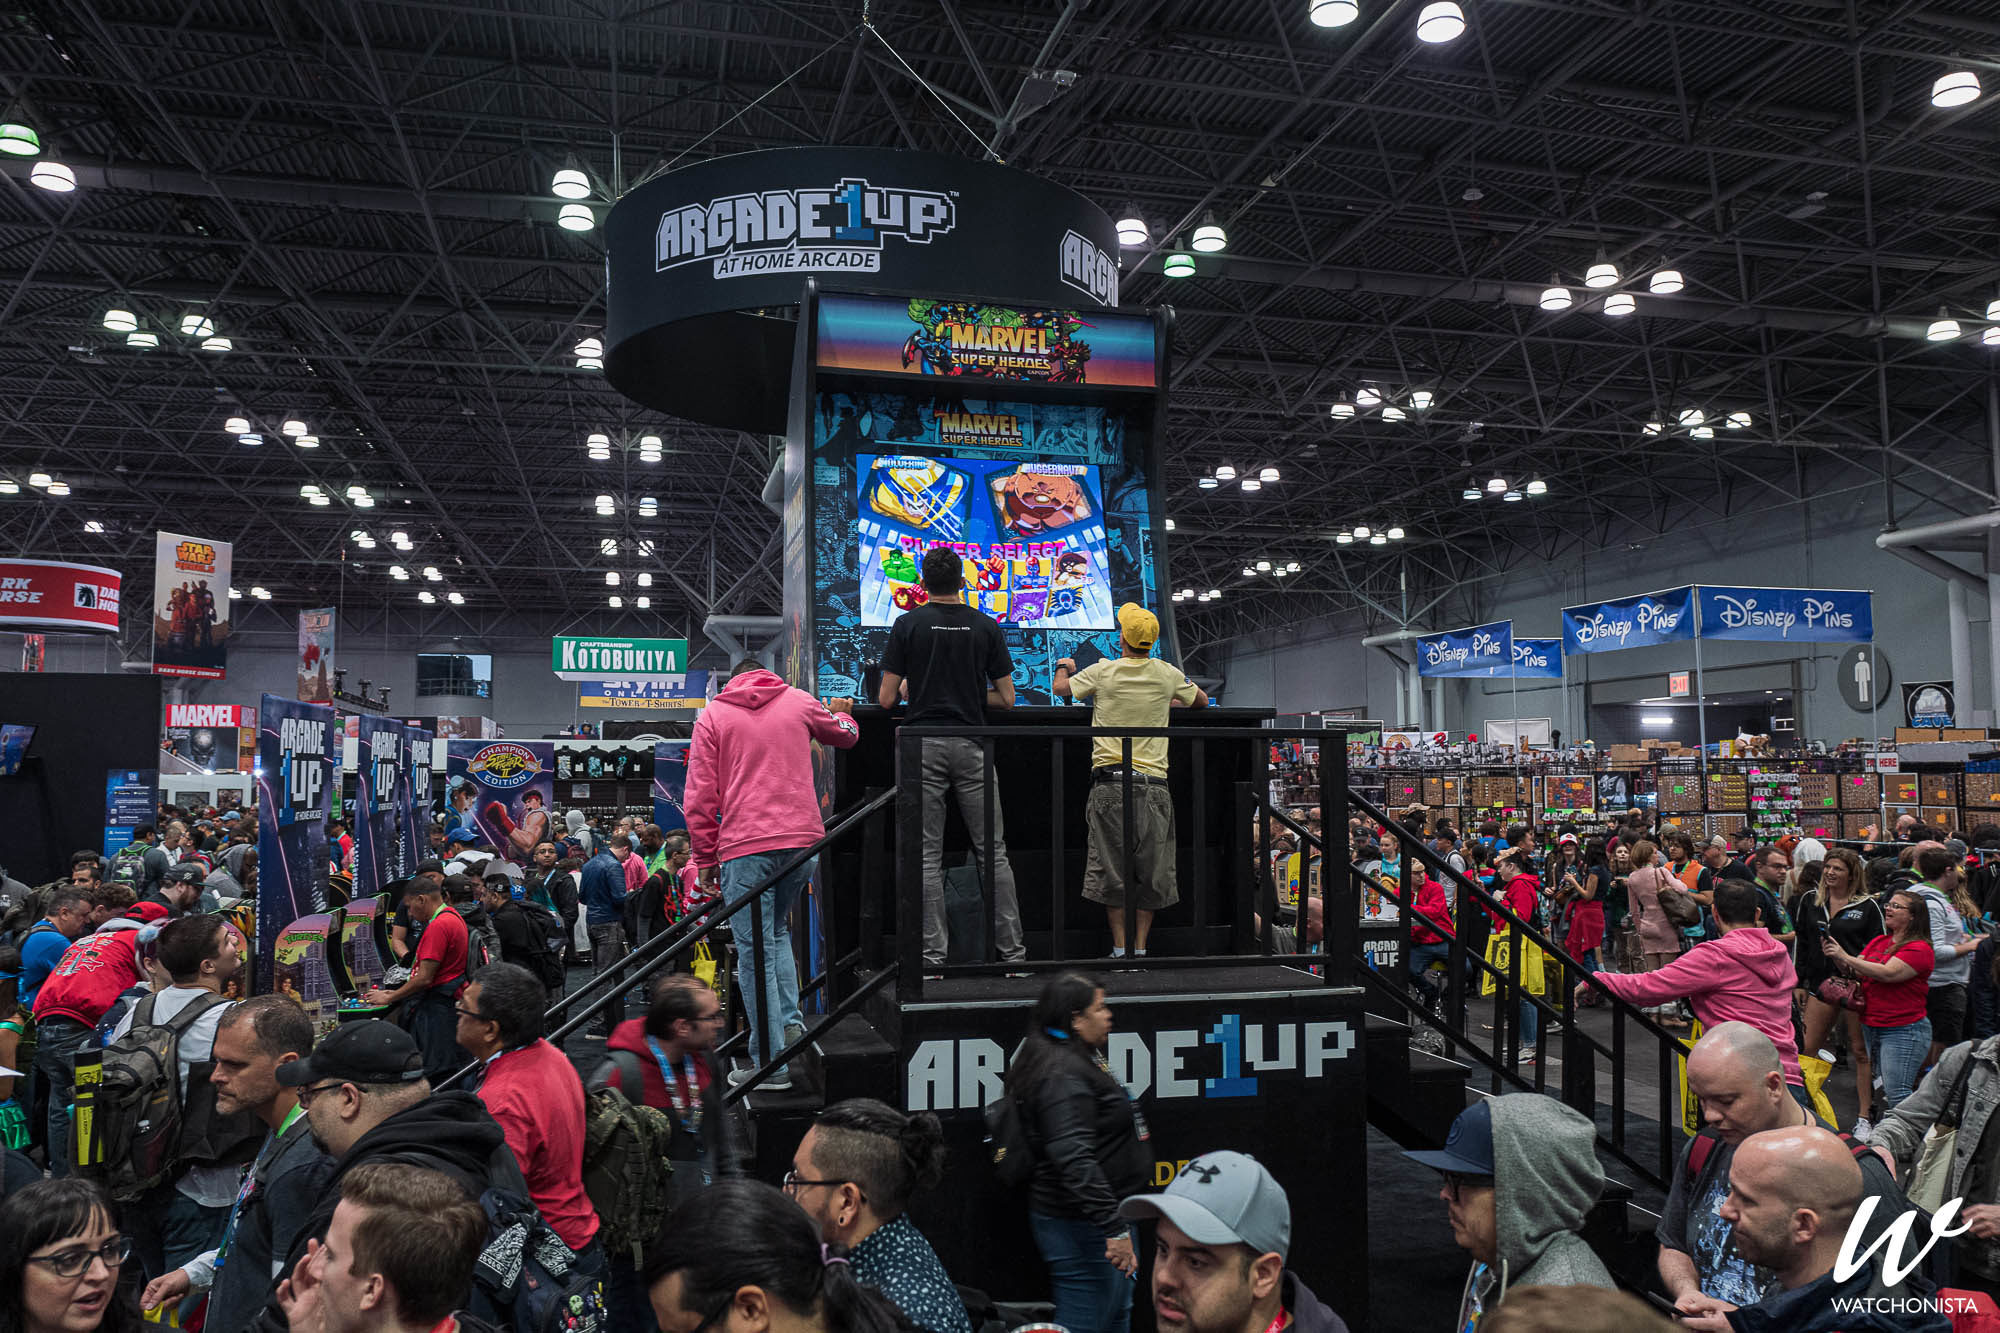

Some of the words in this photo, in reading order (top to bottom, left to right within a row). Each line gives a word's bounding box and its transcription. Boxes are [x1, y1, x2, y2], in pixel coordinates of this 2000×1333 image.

[718, 258, 736, 274] AT
[742, 253, 794, 271] HOME
[799, 252, 875, 268] ARCADE
[1063, 233, 1118, 307] ARCA
[951, 324, 1051, 354] MARVEL
[951, 353, 996, 367] SUPER
[999, 355, 1051, 369] HEROES
[942, 413, 1021, 436] MARVEL
[942, 434, 977, 446] SUPER
[980, 436, 1022, 447] HEROES
[990, 541, 1066, 560] SELECT
[1574, 613, 1632, 645] Disney
[1637, 603, 1679, 633] Pins
[1714, 594, 1795, 638] Disney
[1802, 598, 1853, 629] Pins
[562, 640, 676, 671] KOTOBUKIYA
[1426, 641, 1469, 667] Disney
[1472, 634, 1501, 659] Pins
[1670, 676, 1688, 692] EXIT
[171, 705, 235, 726] MARVEL
[280, 718, 325, 757] ARCADE
[481, 746, 530, 760] CHAMPION
[1879, 758, 1897, 767] HERE
[484, 774, 527, 785] EDITION
[283, 933, 325, 944] TURTLES
[1363, 940, 1399, 952] ARCAD
[908, 1014, 1355, 1111] ARDE1UP
